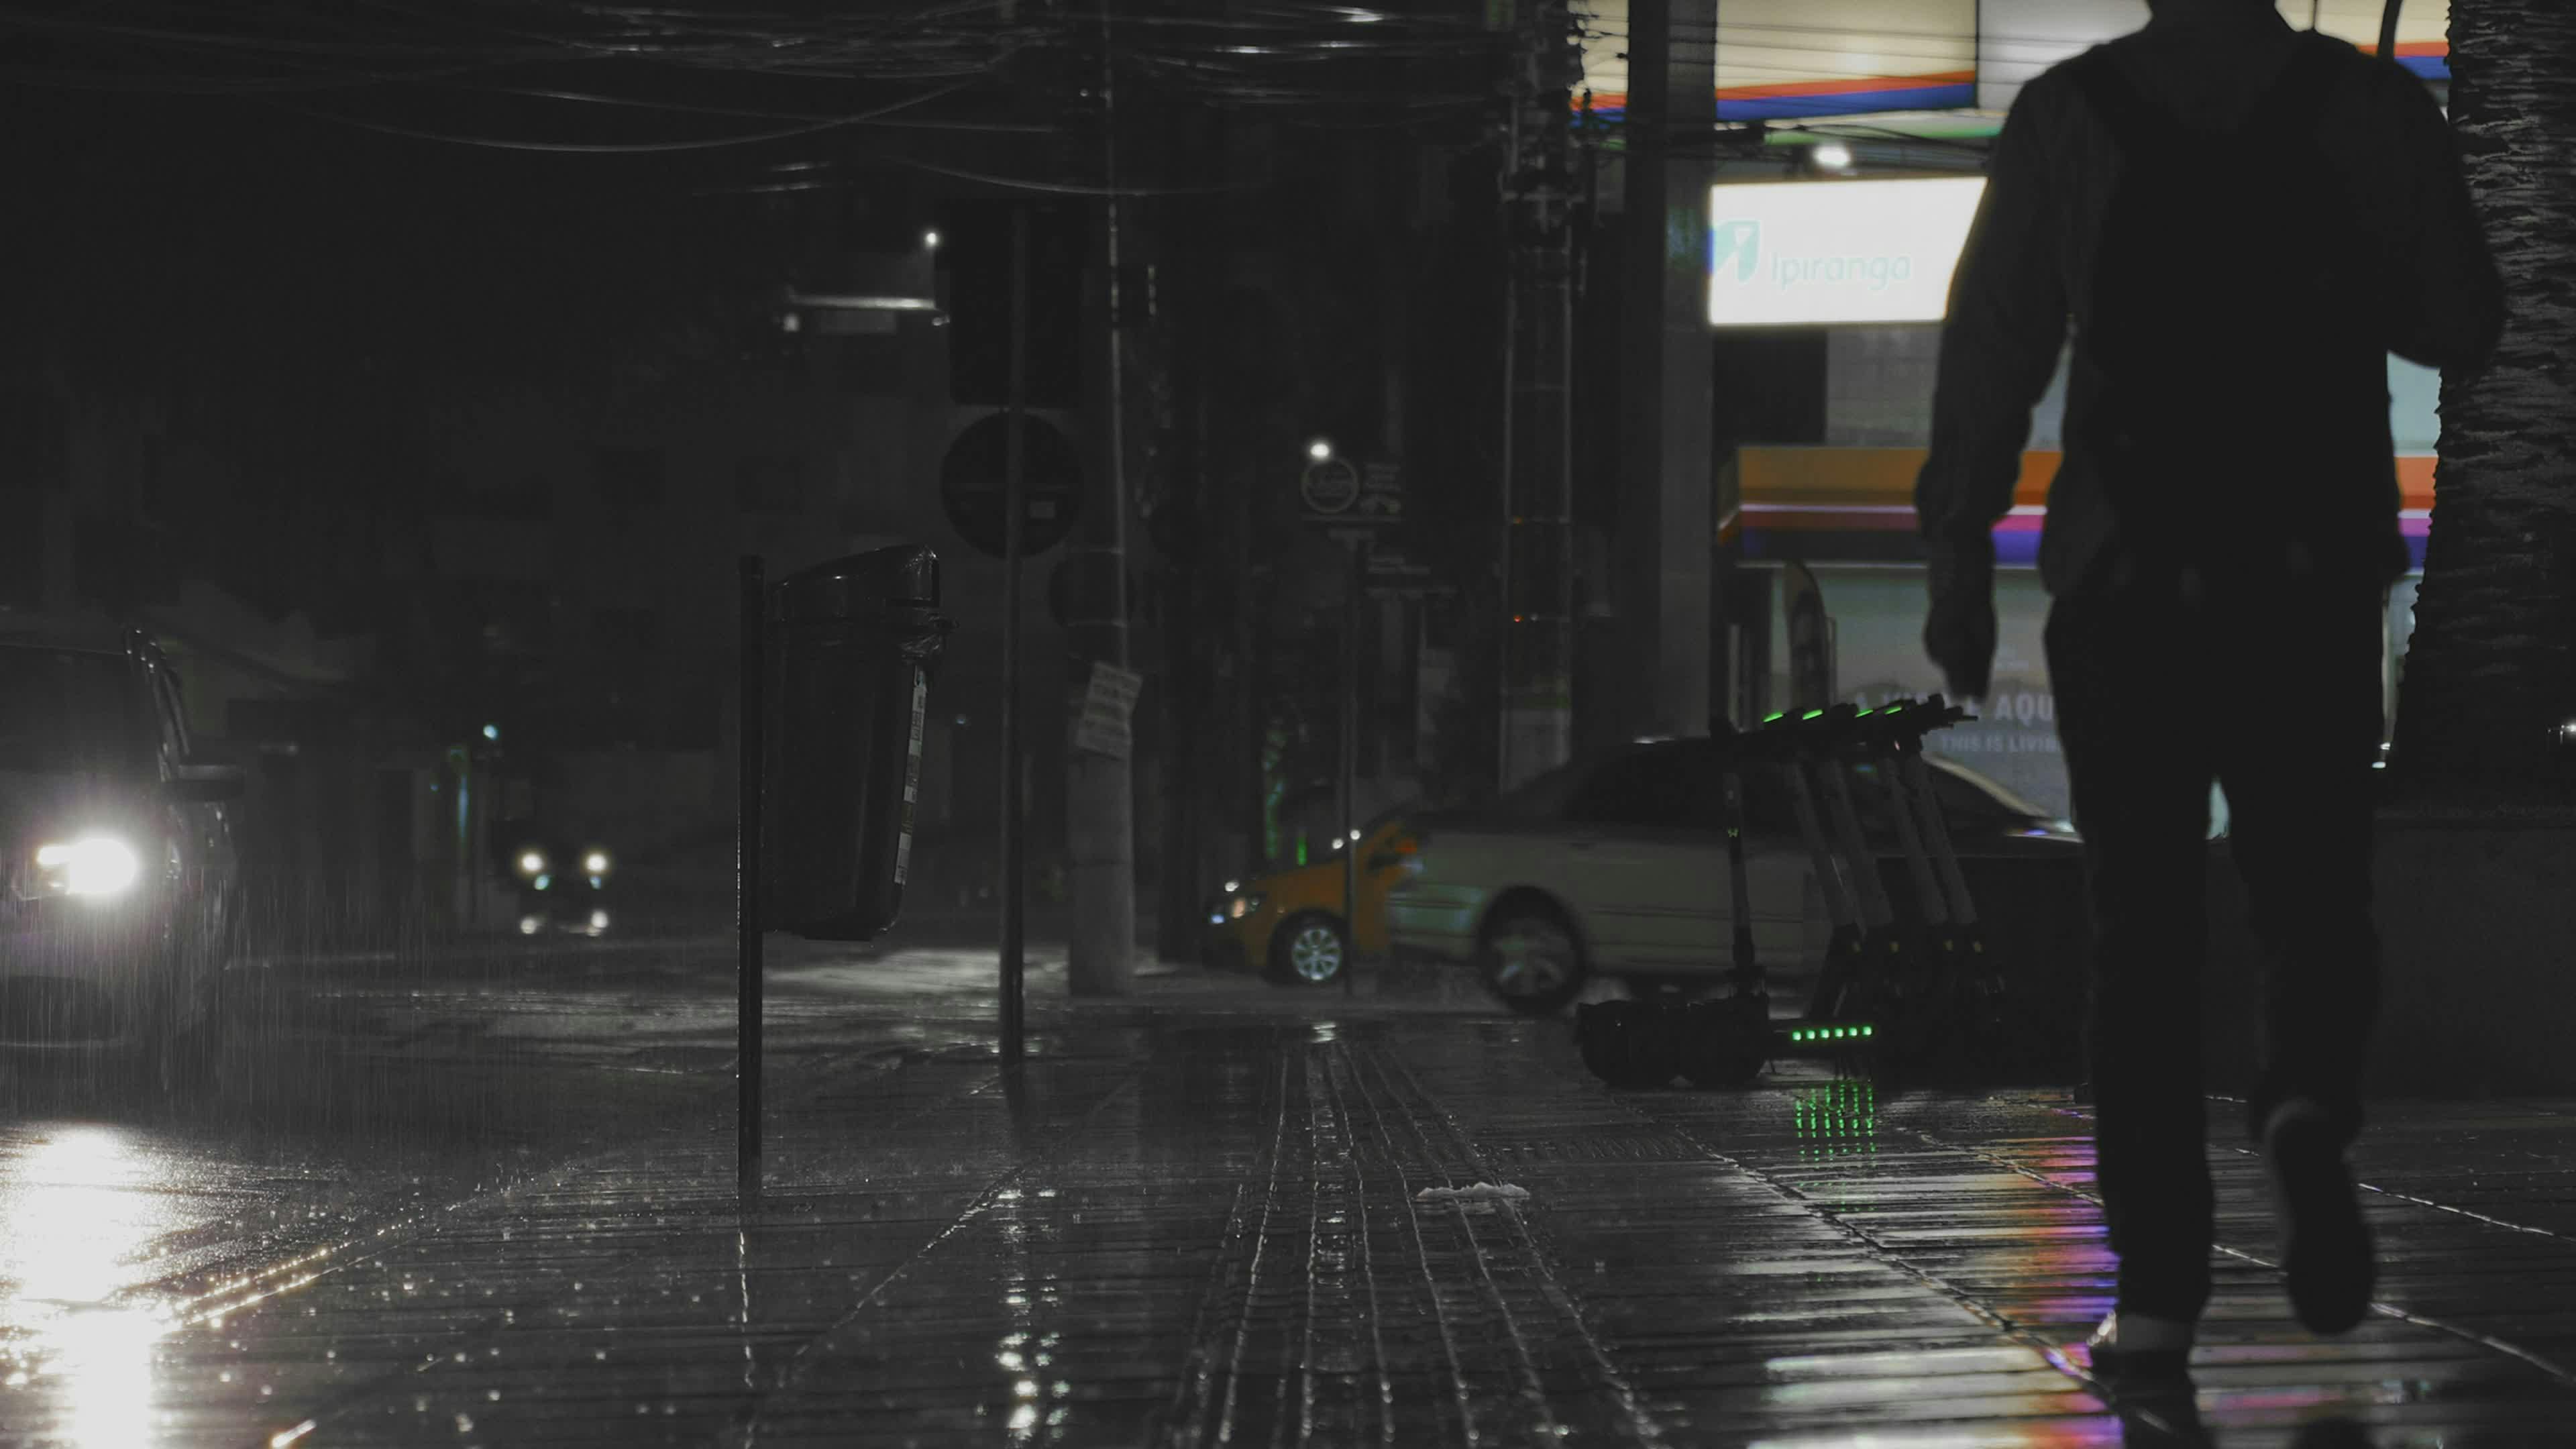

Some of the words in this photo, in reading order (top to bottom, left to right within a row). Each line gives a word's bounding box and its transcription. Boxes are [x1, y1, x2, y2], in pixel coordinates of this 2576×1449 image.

[1772, 254, 1910, 290] Ipiranga
[1942, 735, 1978, 752] THIS
[1985, 735, 2003, 752] IS
